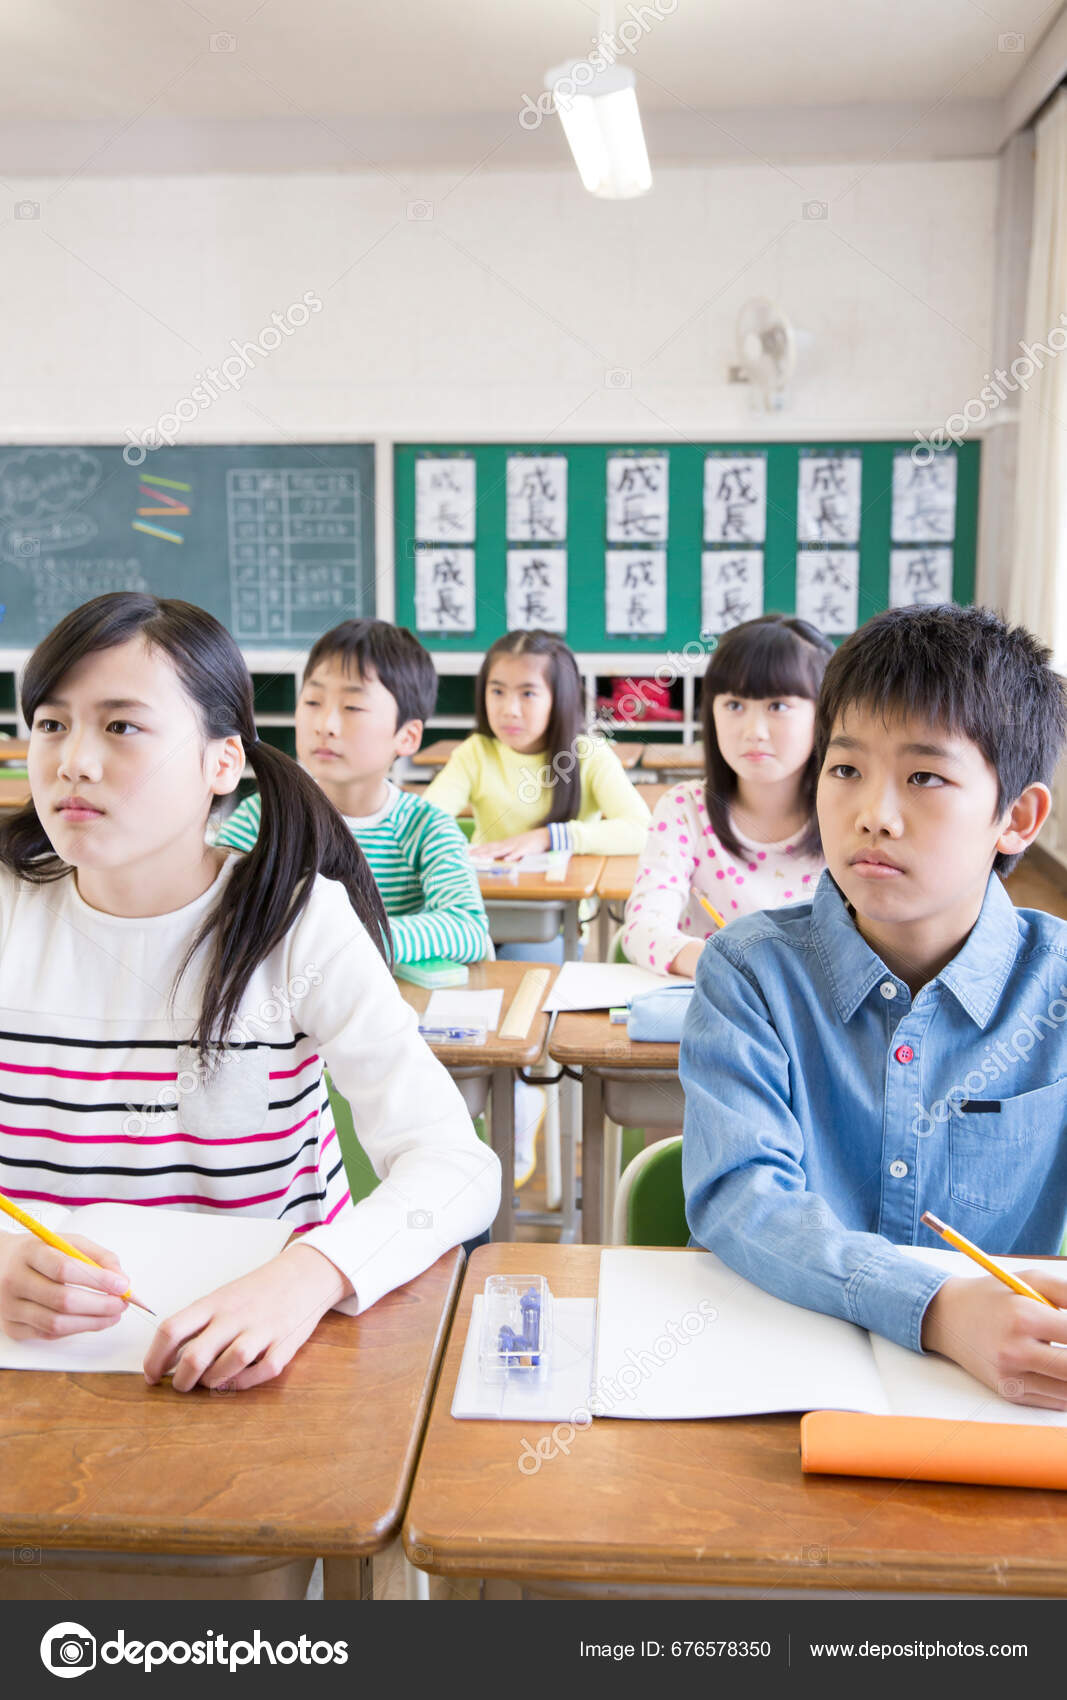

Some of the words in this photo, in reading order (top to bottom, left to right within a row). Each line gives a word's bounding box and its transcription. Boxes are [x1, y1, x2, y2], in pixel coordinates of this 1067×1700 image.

[517, 465, 557, 537] 成長
[616, 463, 661, 537] 成長
[717, 465, 757, 541] 成長
[811, 459, 848, 538] 成長
[432, 557, 465, 626] 成長
[520, 558, 554, 623] 成長
[623, 559, 655, 628] 成長
[715, 557, 750, 628] 成長
[811, 555, 851, 626] 成長
